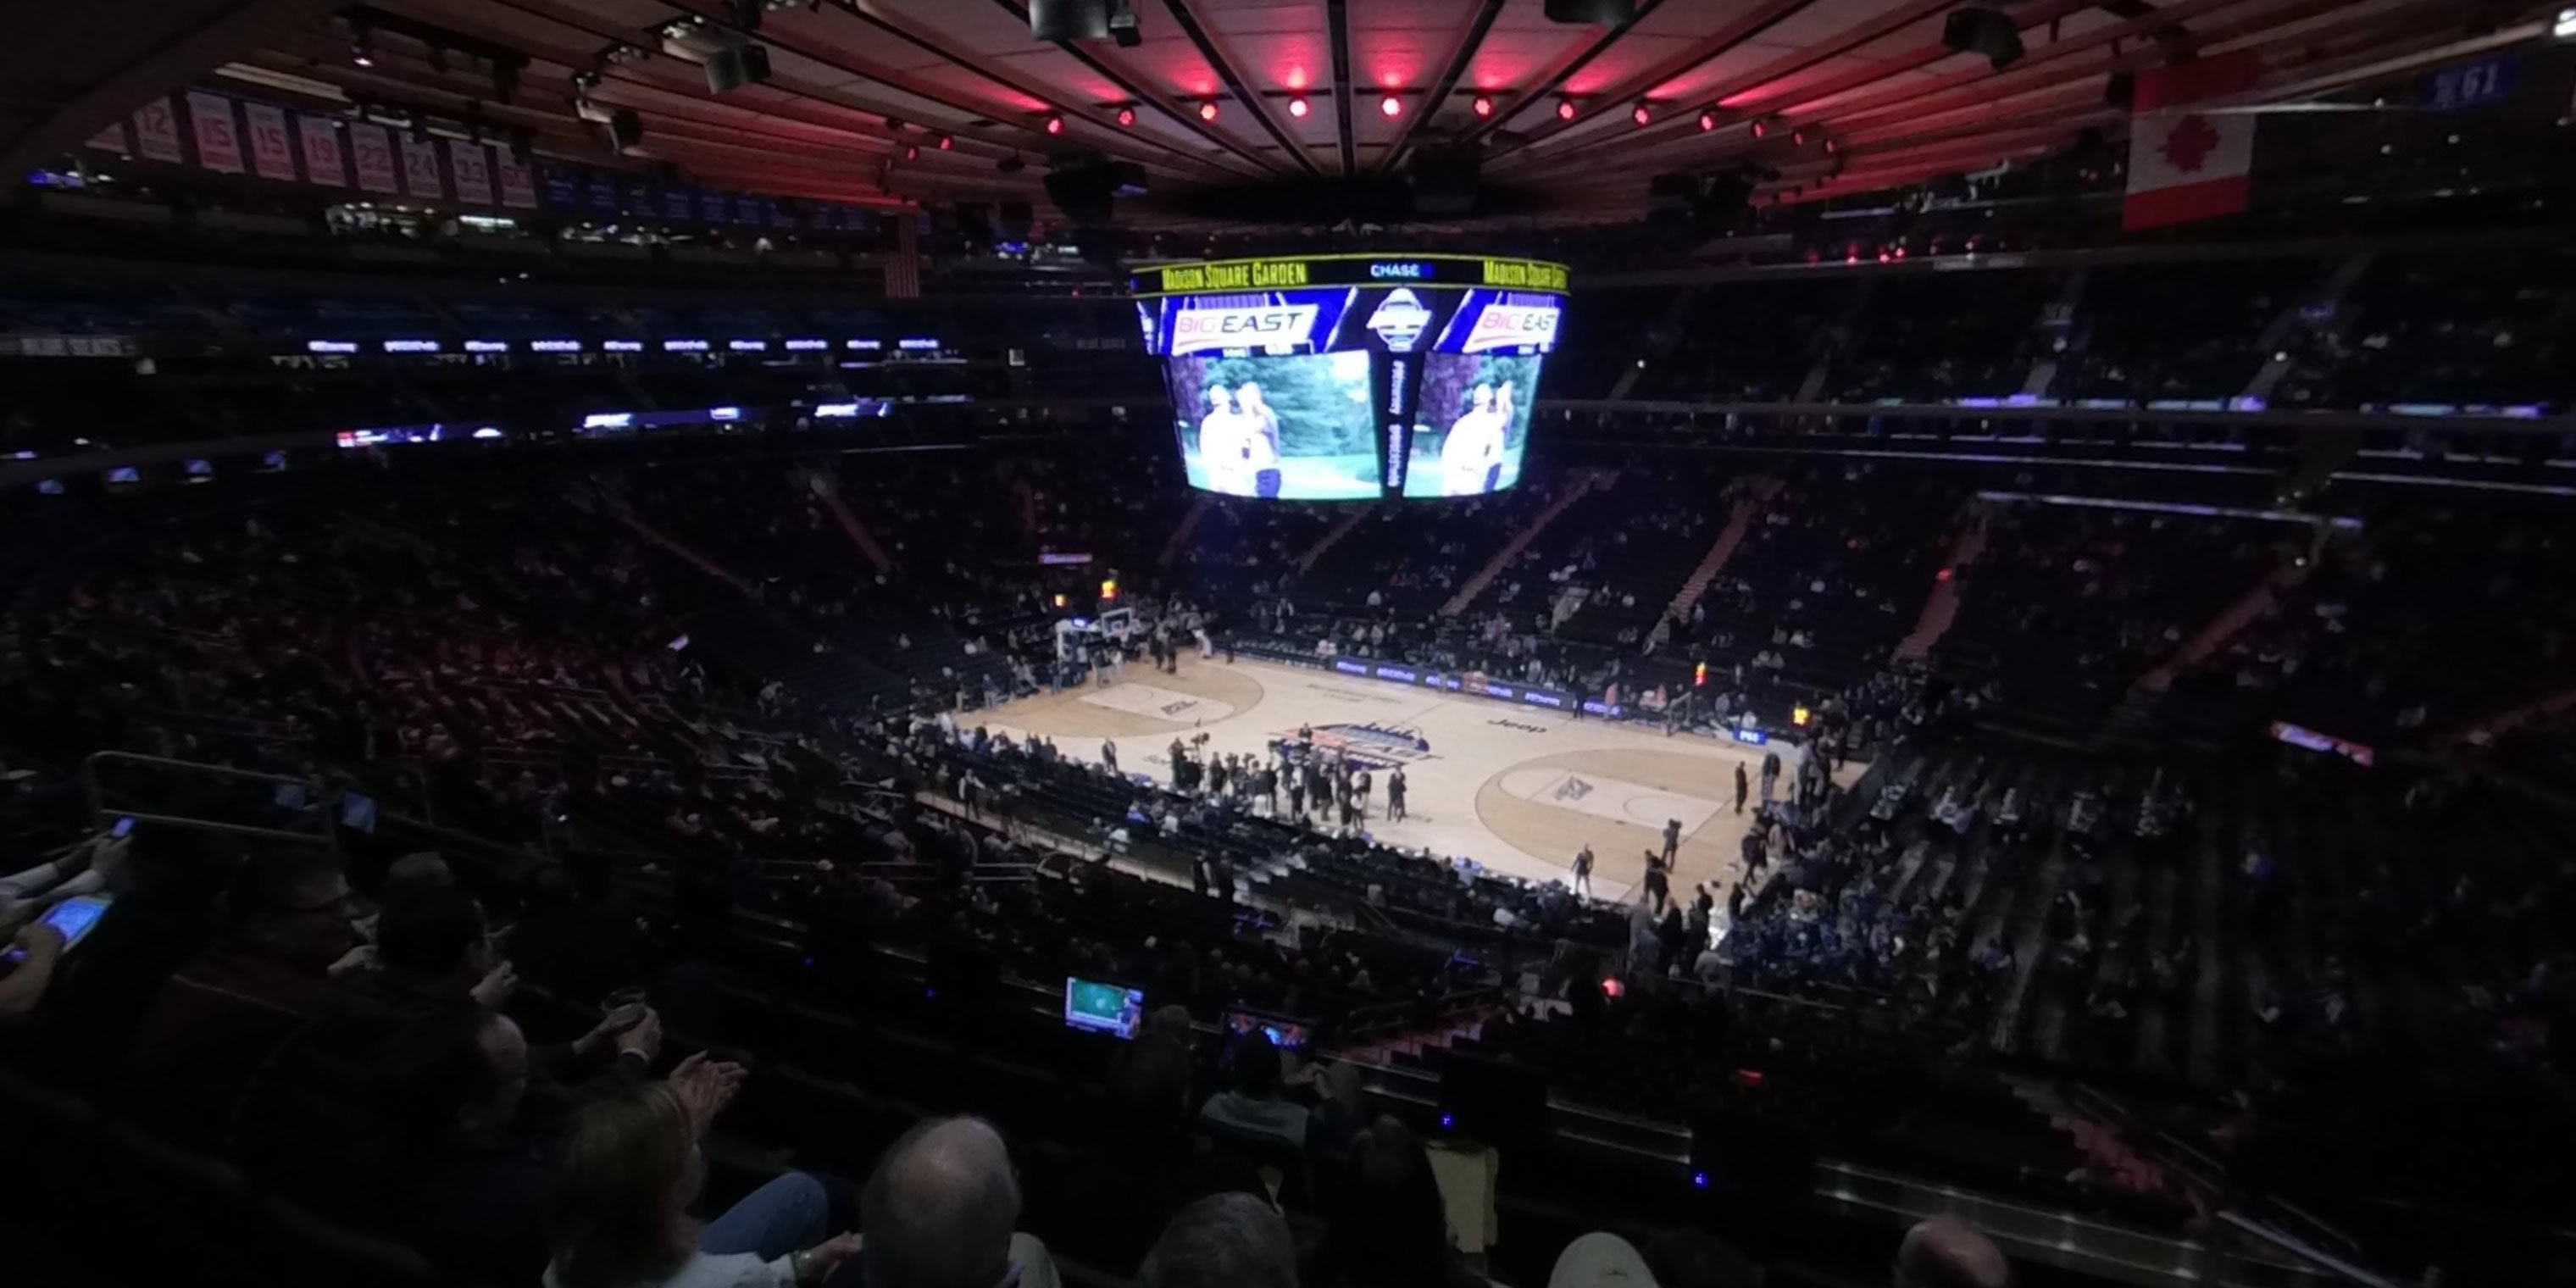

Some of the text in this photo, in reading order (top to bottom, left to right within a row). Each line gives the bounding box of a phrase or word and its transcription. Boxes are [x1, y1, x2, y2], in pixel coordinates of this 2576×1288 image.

[144, 105, 169, 136] 12
[200, 116, 230, 147] 15
[256, 127, 285, 155] 15
[310, 136, 336, 163] 19
[407, 153, 436, 179] 24
[1163, 262, 1307, 291] MADISON SQUARE GARDEN
[1370, 264, 1419, 277] CHASE
[1484, 261, 1526, 285] MADISON
[1179, 312, 1303, 333] BIG EAST
[1481, 312, 1521, 330] BIG
[1487, 719, 1547, 733] Jeep
